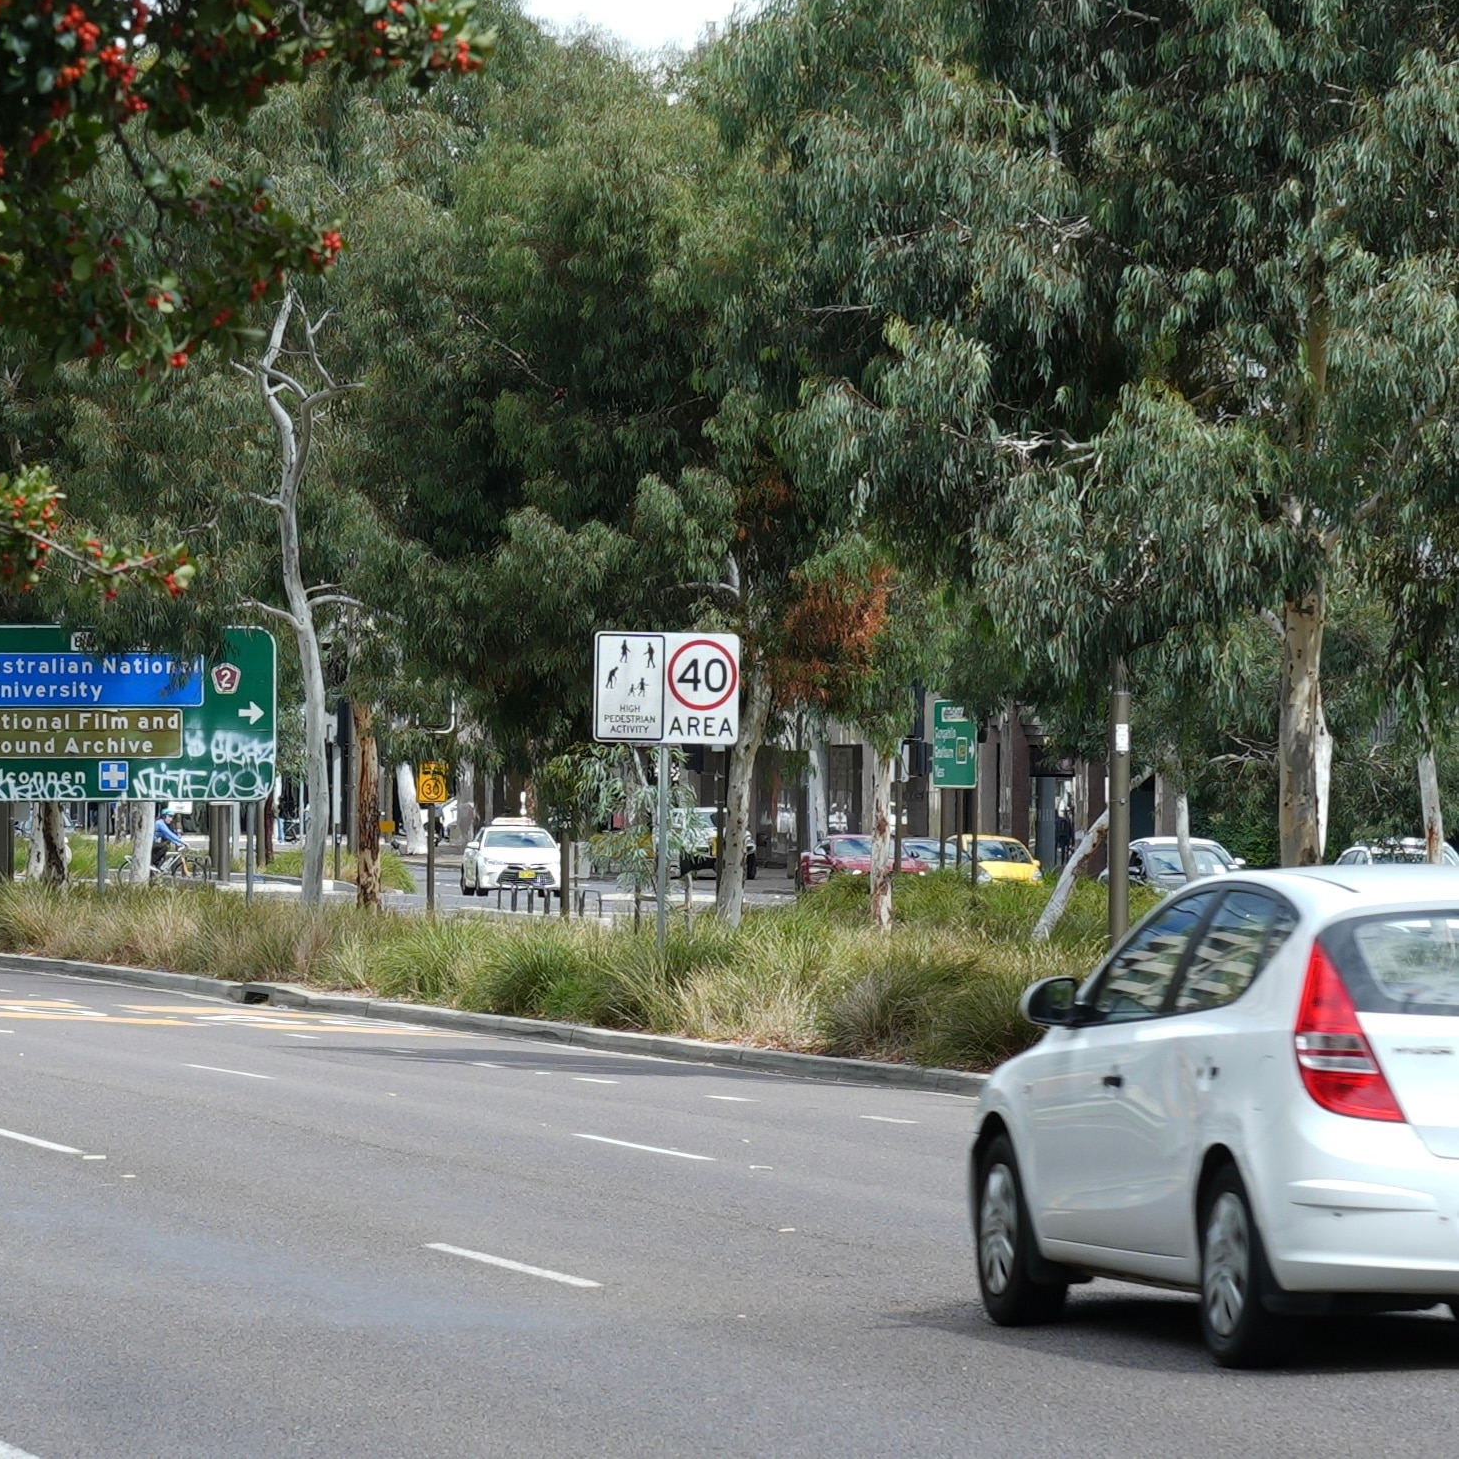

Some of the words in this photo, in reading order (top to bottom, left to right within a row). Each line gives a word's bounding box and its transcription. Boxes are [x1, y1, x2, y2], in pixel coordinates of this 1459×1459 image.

[220, 669, 232, 688] 2
[677, 658, 728, 692] 40
[620, 705, 641, 713] HIGH
[79, 713, 128, 730] Film
[137, 713, 179, 730] and
[604, 714, 656, 723] PEDESTRIAN
[668, 716, 734, 738] AREA
[609, 725, 650, 734] ACTIVITY
[64, 737, 154, 754] Archive
